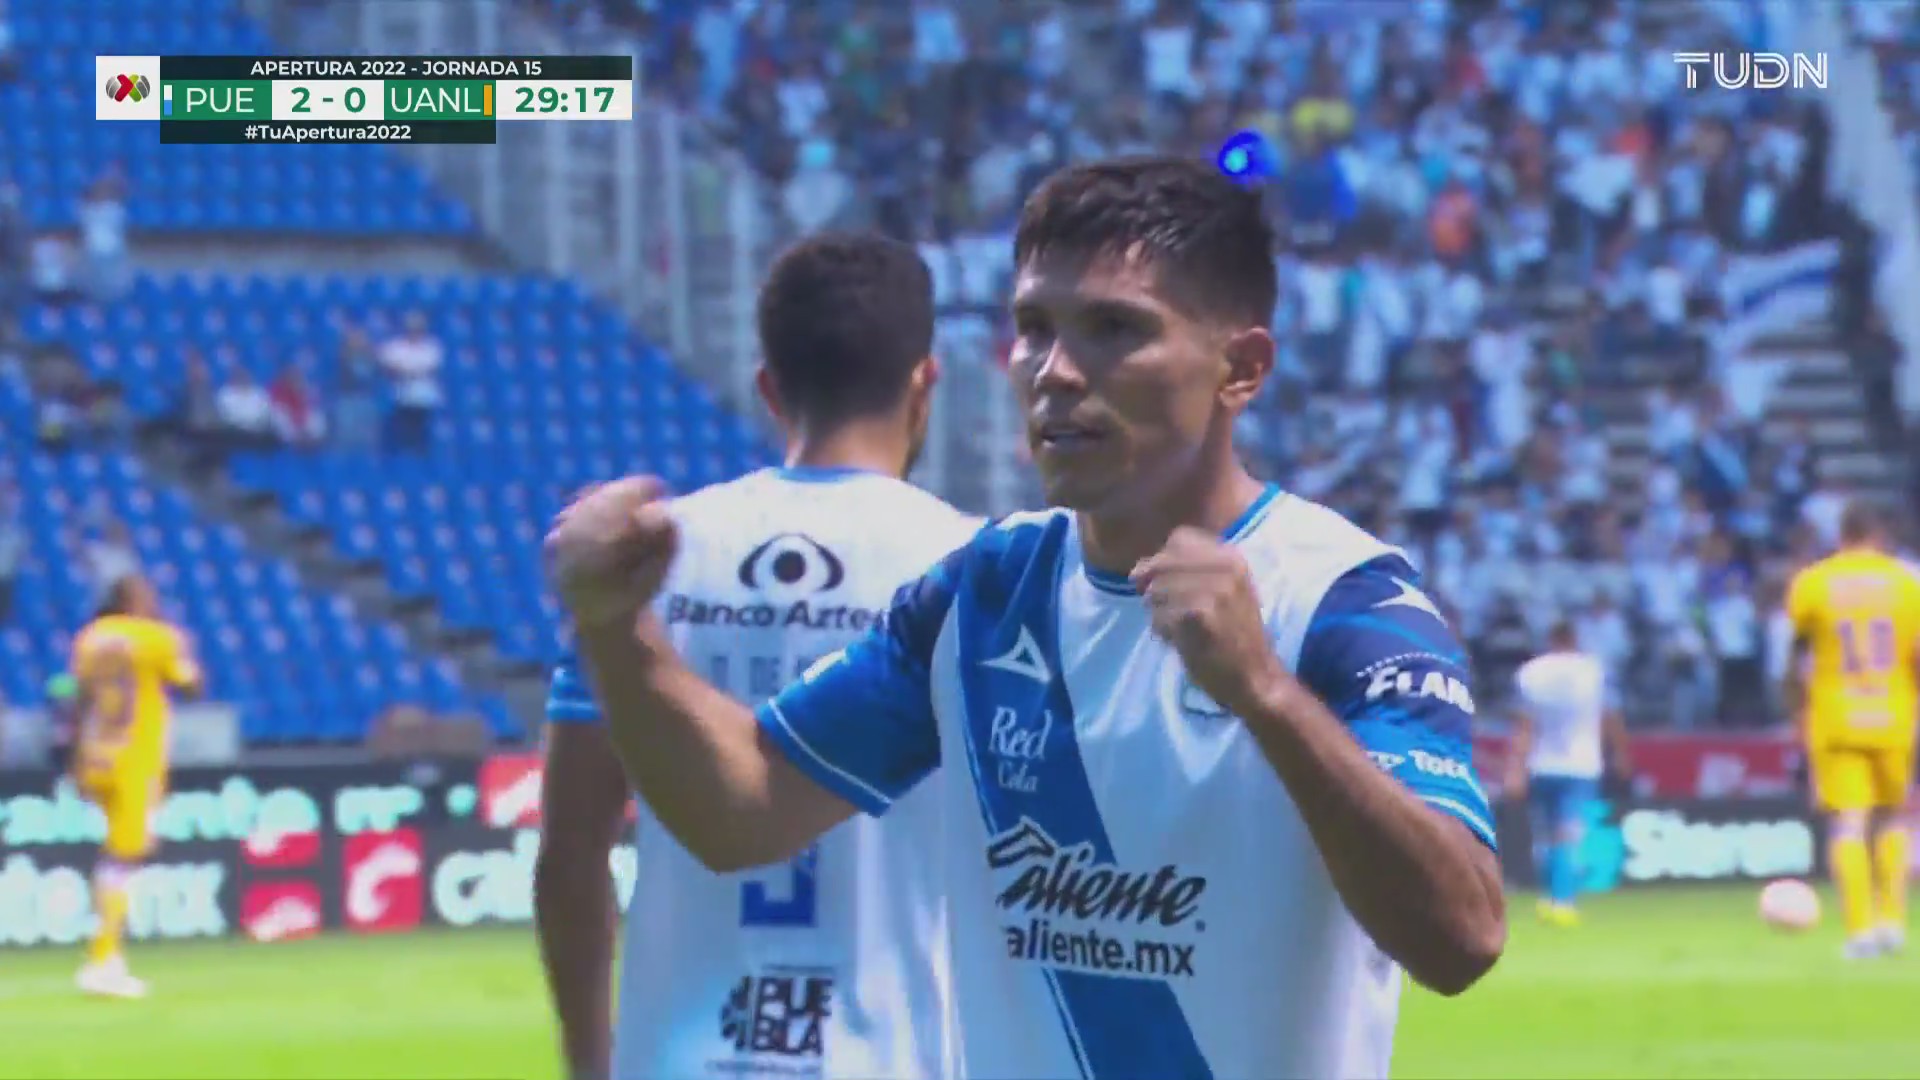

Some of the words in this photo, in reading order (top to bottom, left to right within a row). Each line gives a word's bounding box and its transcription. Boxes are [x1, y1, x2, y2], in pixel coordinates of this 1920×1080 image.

[668, 594, 775, 628] Banco
[989, 706, 1053, 761] Red
[997, 758, 1040, 793] Cola
[1005, 917, 1196, 978] aliente.mx
[755, 975, 834, 1018] PUE
